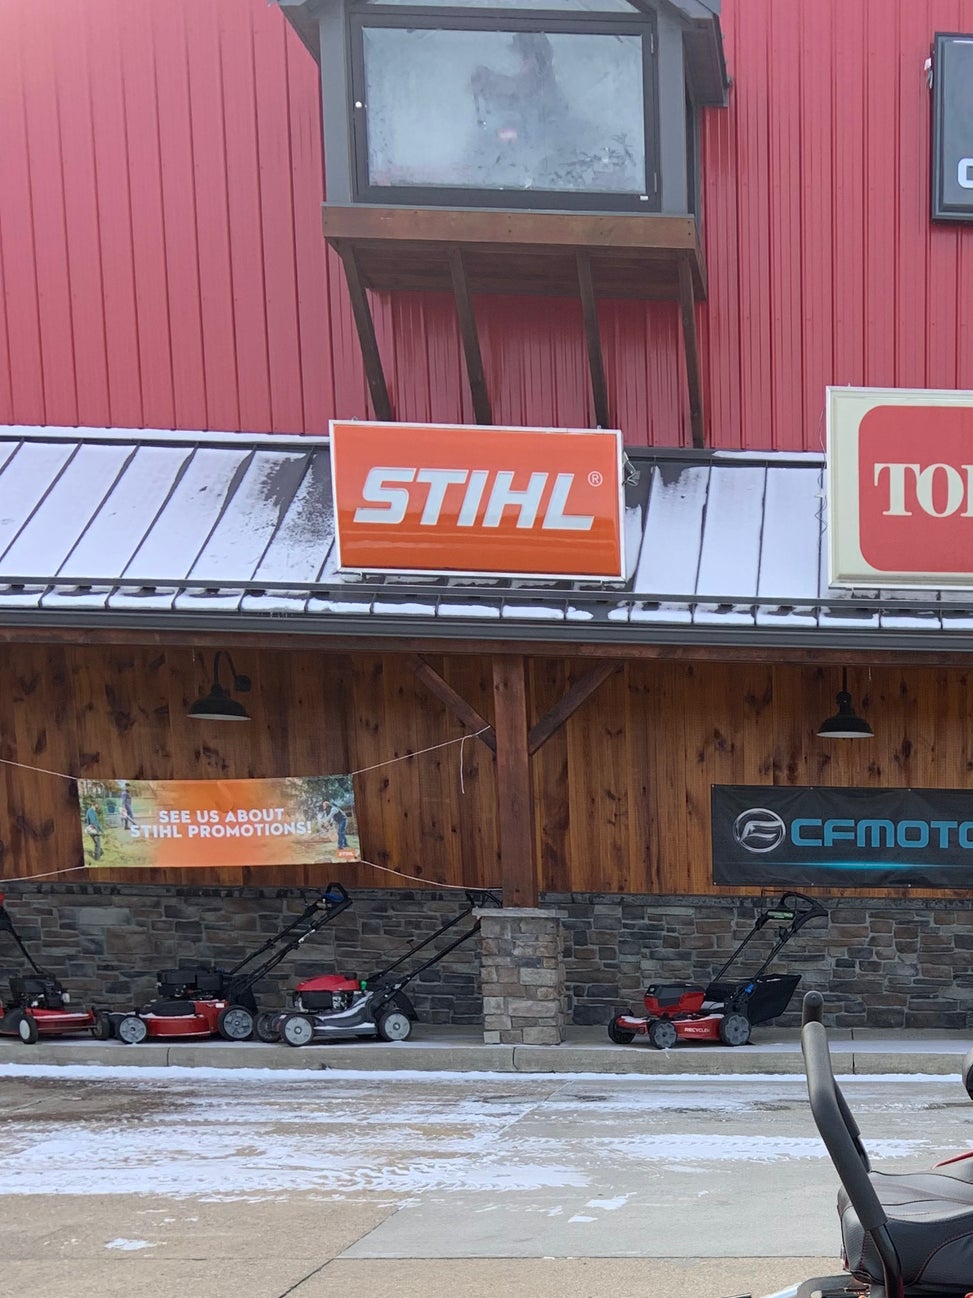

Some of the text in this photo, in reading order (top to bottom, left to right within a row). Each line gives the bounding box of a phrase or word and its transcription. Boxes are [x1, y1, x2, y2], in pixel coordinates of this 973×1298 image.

[353, 466, 595, 531] STIHL
[159, 808, 284, 824] SEE US ABOUT
[130, 821, 312, 839] STIHL PROMOTIONS!
